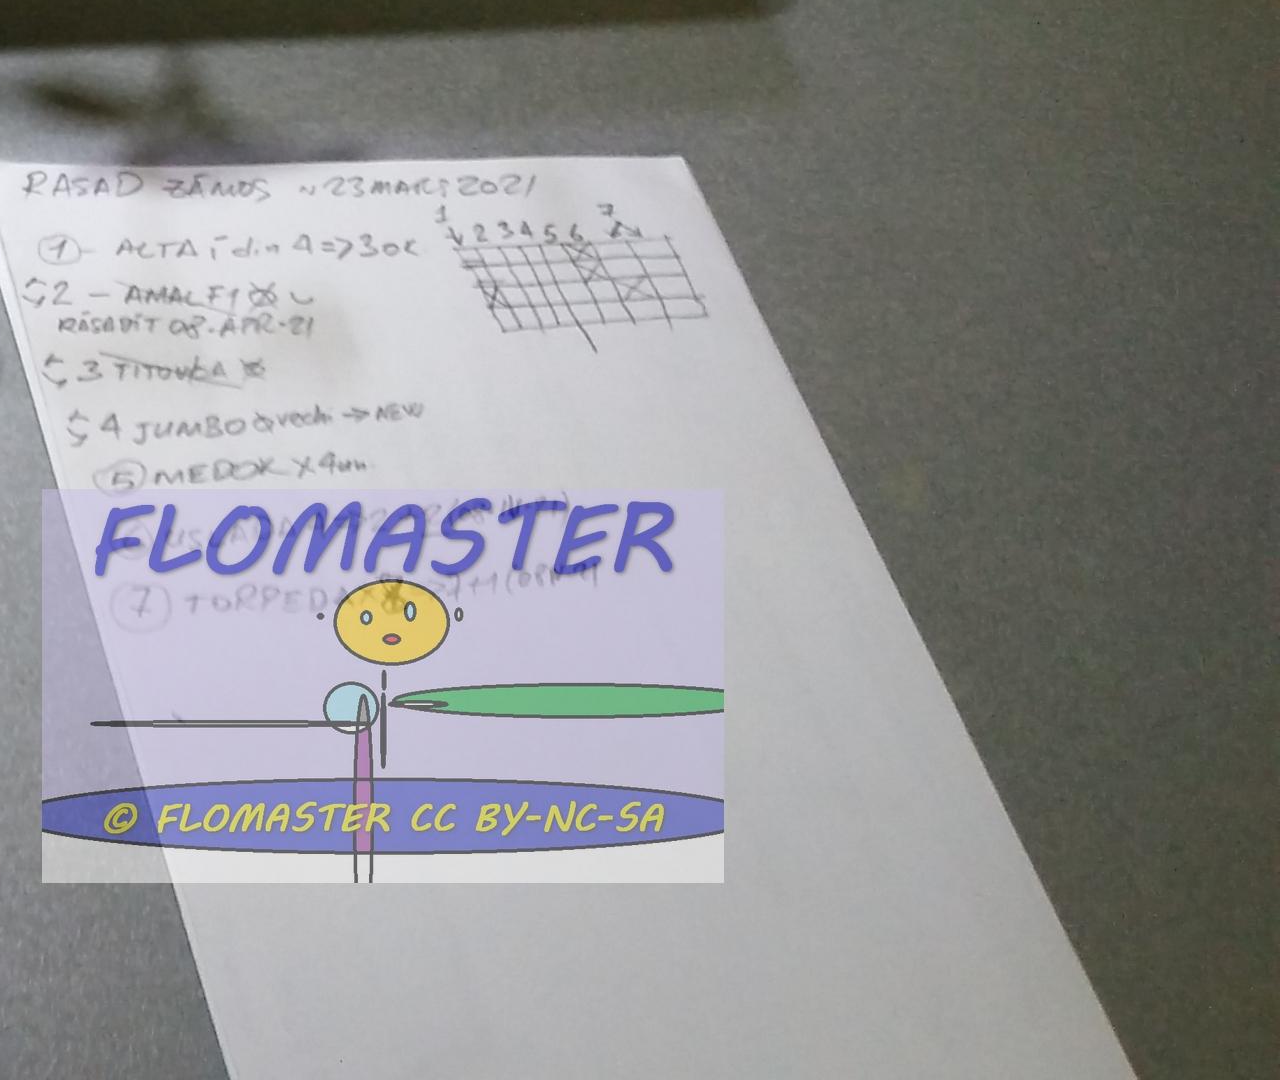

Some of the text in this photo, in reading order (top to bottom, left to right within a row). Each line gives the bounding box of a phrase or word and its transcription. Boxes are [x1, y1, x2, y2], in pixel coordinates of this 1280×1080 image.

[457, 173, 537, 198] 2021
[473, 220, 584, 245] 2 3 4 5 6
[132, 414, 248, 445] JUMBO
[375, 402, 425, 422] NEW
